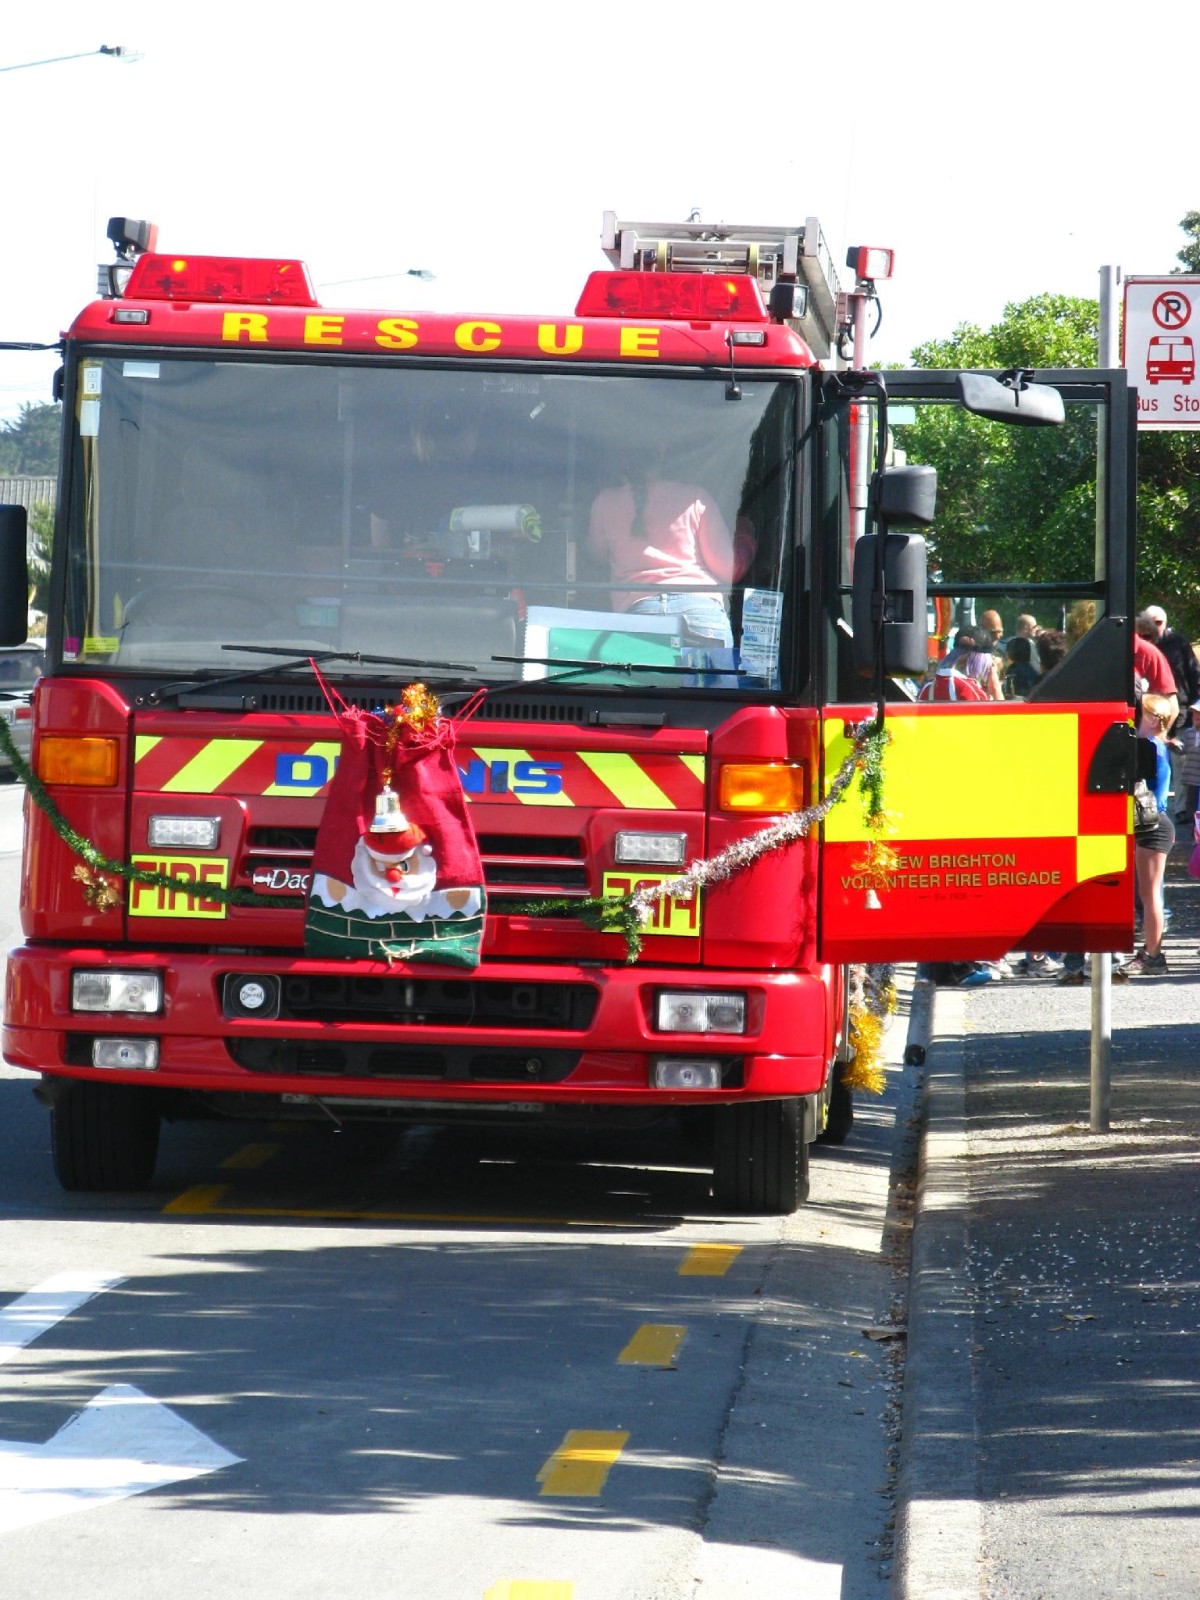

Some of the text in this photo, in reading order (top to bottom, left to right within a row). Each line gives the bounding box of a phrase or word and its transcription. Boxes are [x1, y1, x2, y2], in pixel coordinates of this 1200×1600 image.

[221, 311, 660, 358] RESCUE
[1173, 394, 1200, 411] Sto
[274, 752, 564, 795] DNIS
[887, 853, 1017, 869] EW BRIGHTON
[131, 861, 225, 912] FIRE
[945, 872, 982, 888] FIRE
[987, 870, 1062, 887] BRIGADE
